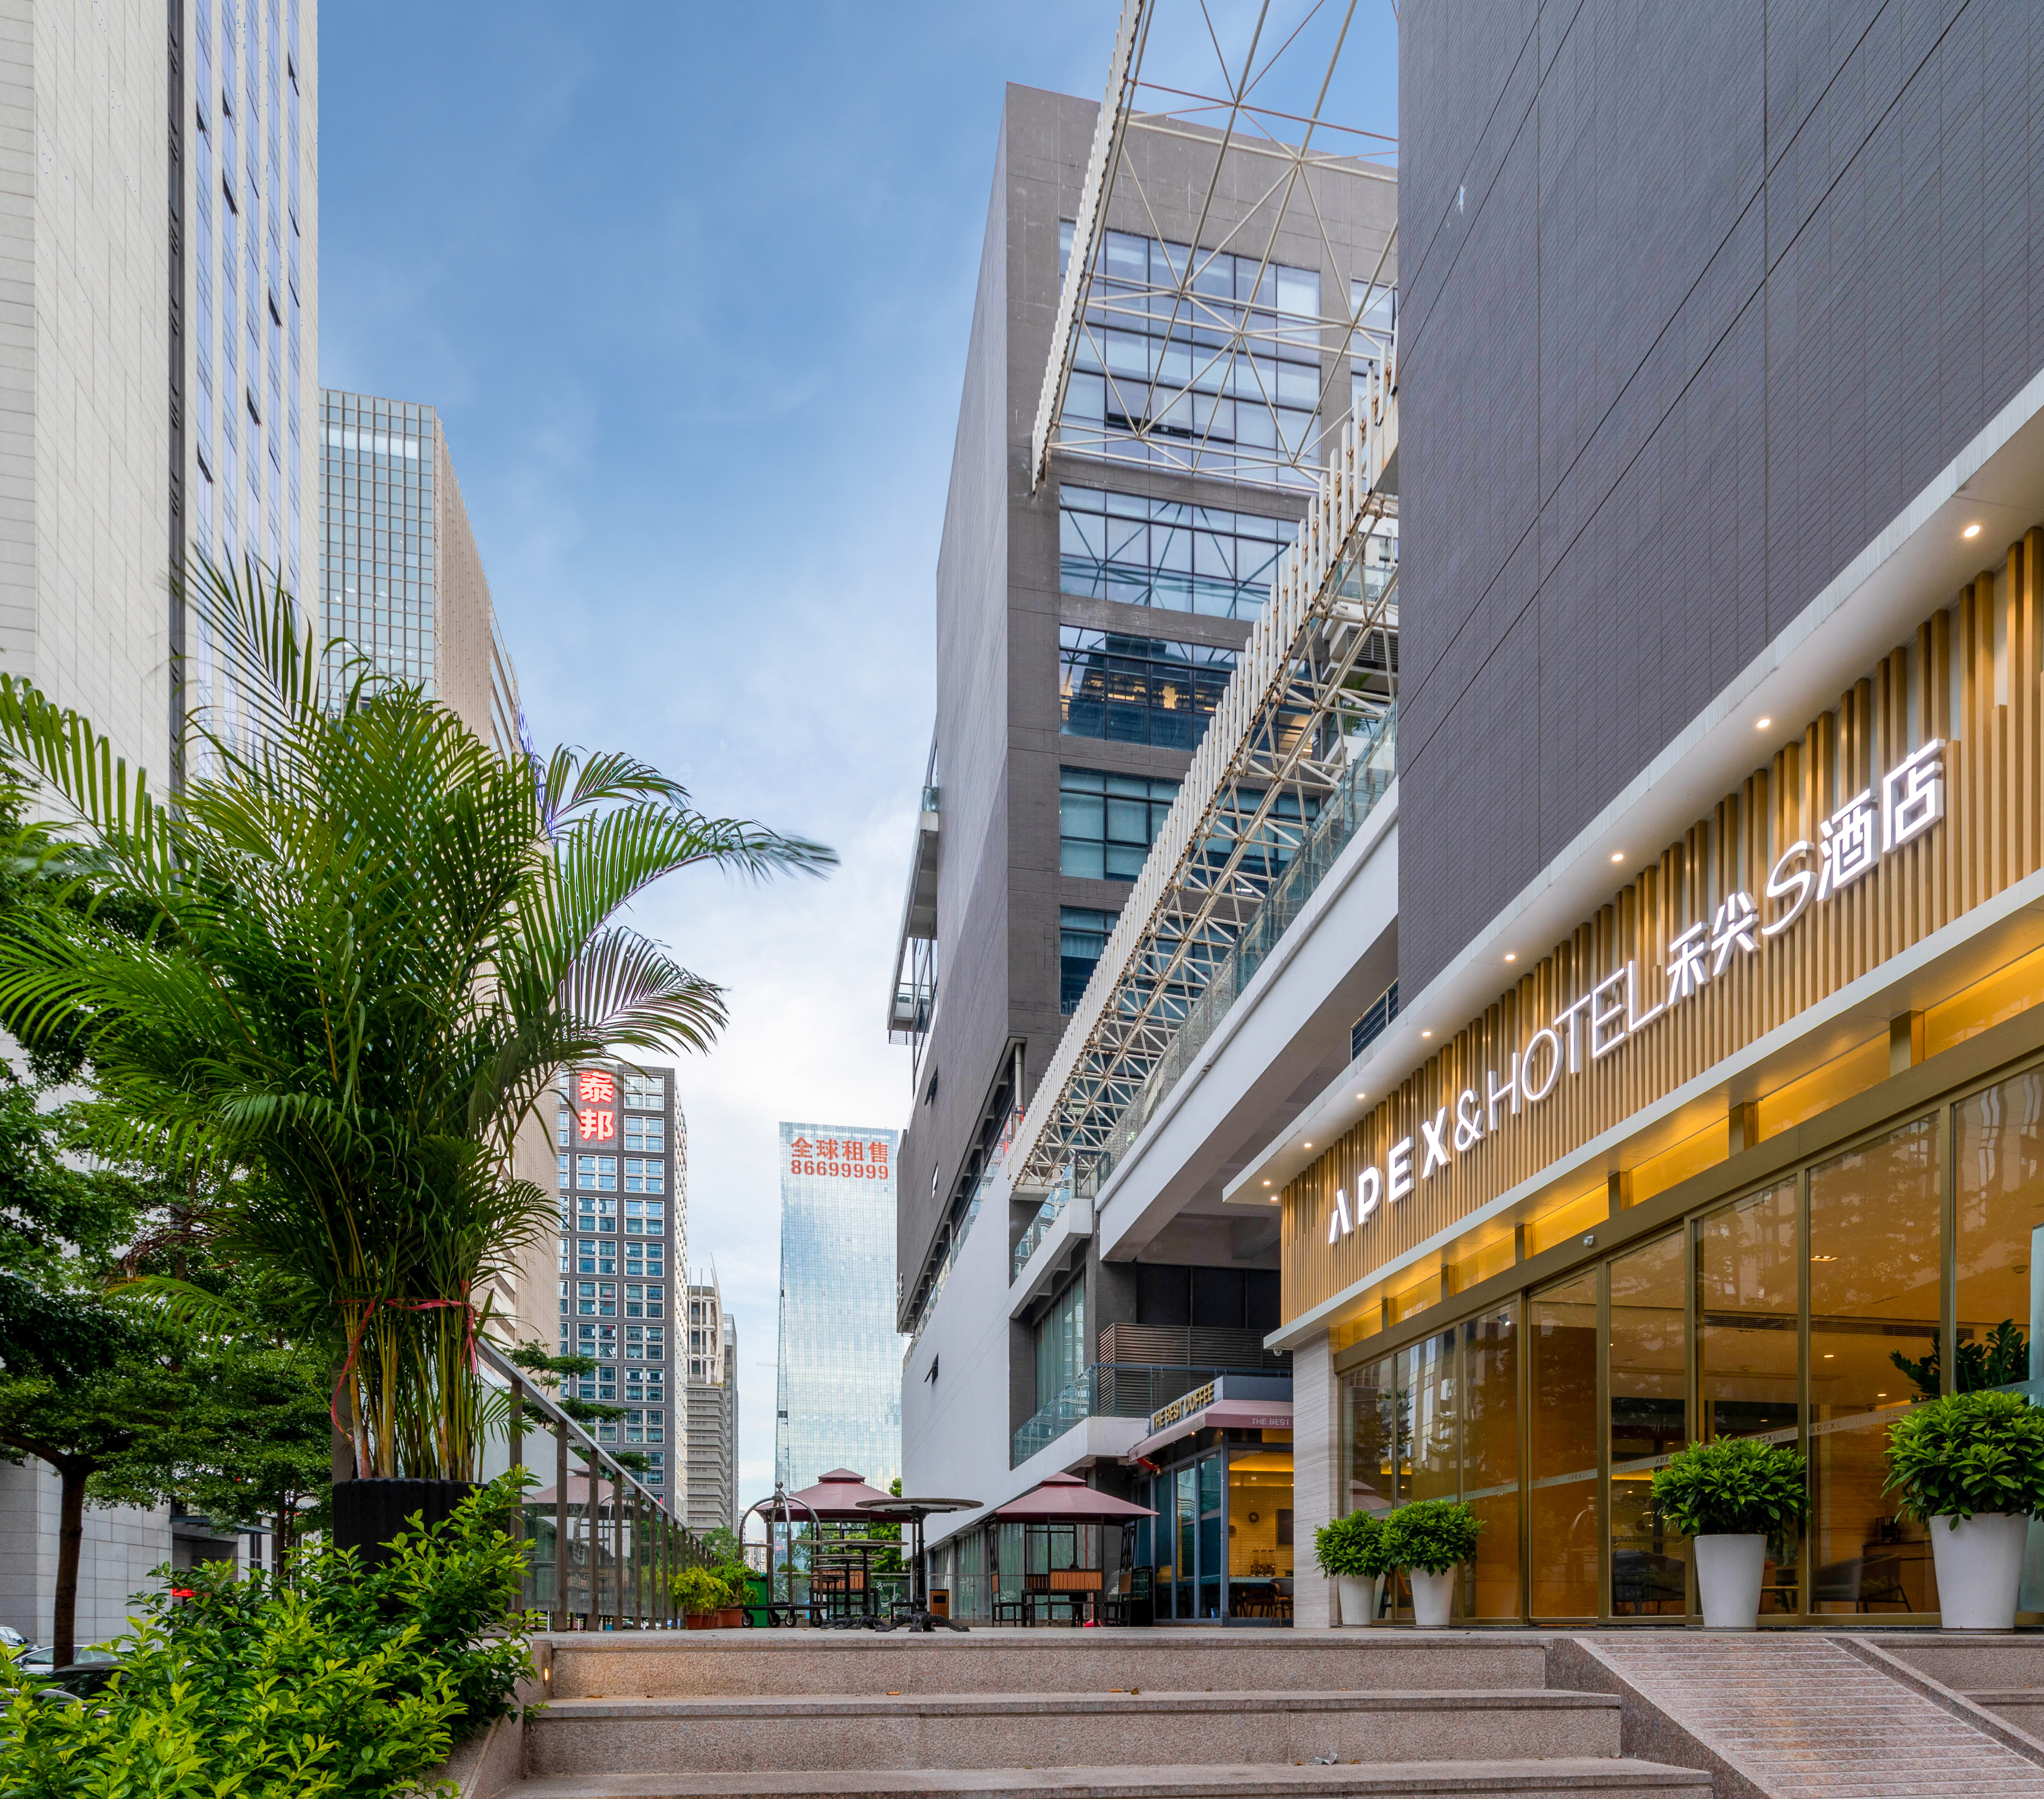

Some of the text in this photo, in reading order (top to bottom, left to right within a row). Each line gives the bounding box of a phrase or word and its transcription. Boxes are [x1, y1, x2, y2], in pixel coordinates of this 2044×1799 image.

[579, 1071, 614, 1141] 泰邦
[791, 1136, 888, 1163] 全球租售
[791, 1159, 888, 1179] 86699999
[1153, 1383, 1214, 1430] THE BEST COFFEE
